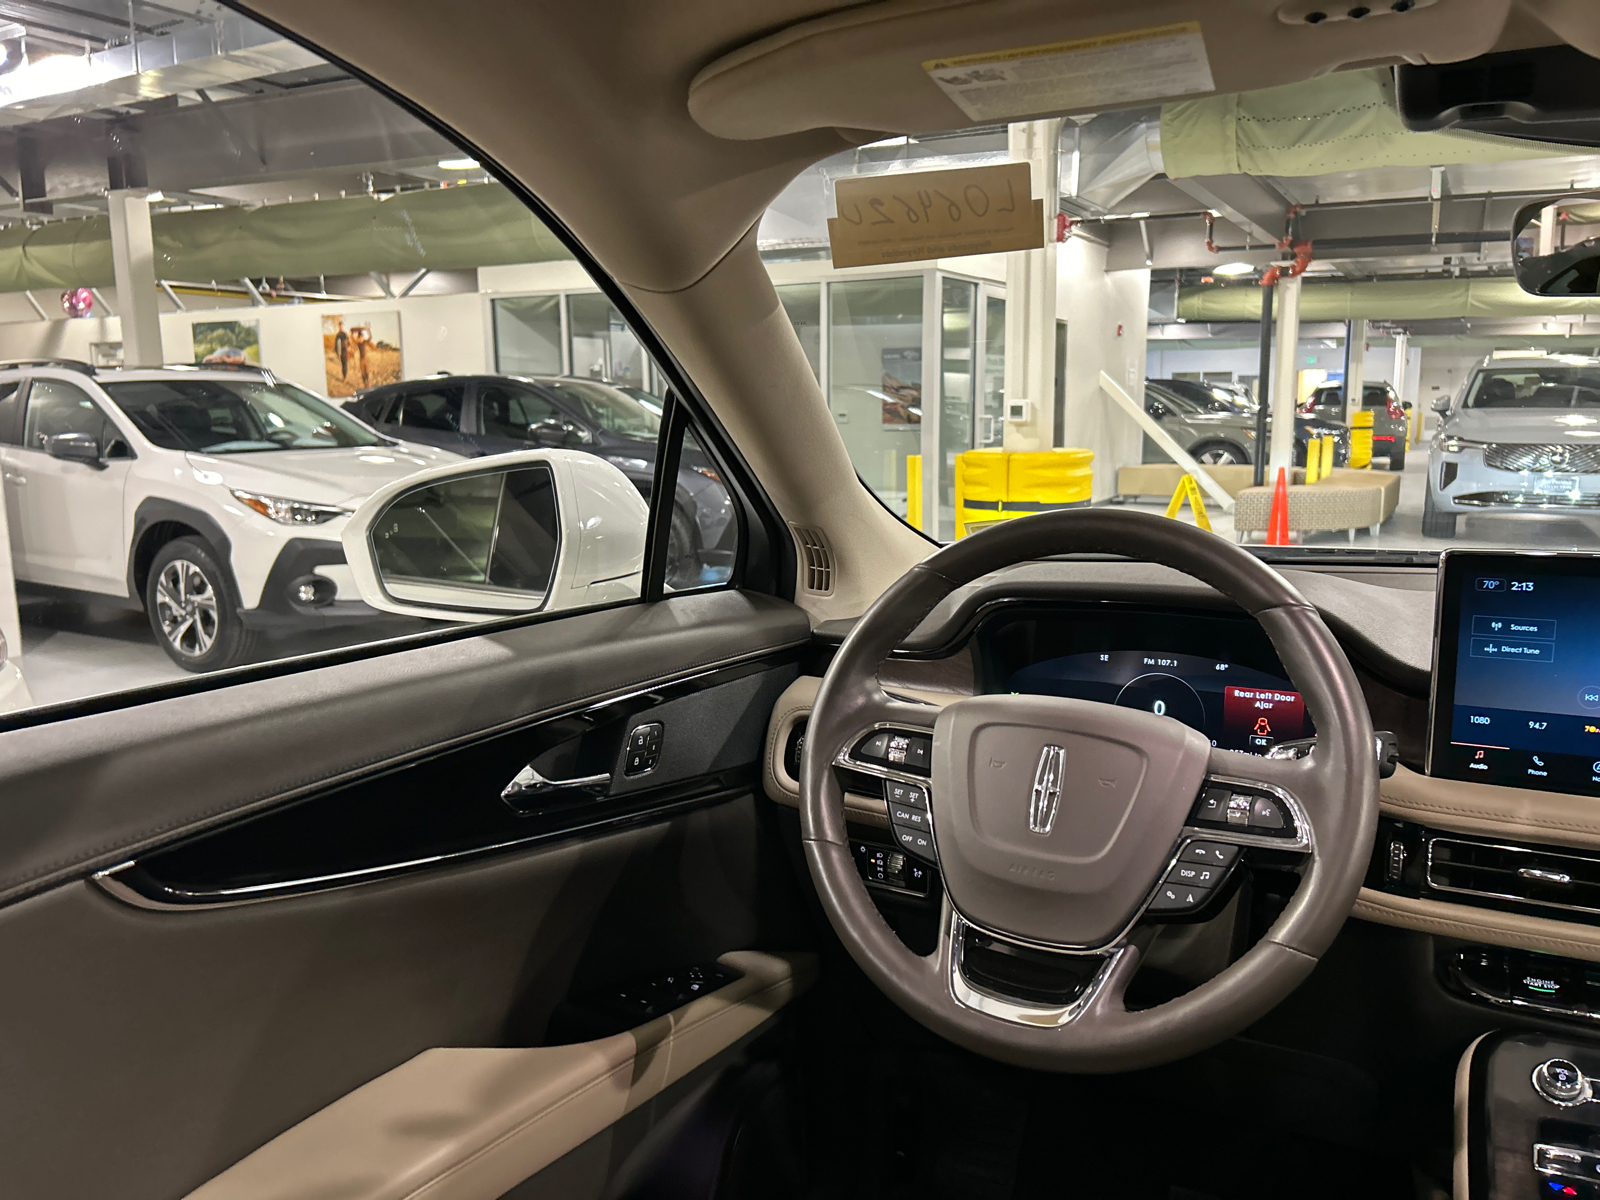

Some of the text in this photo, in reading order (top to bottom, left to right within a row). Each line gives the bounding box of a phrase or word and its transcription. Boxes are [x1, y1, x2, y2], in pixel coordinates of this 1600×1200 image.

[1510, 582, 1534, 591] 2:13
[1510, 624, 1538, 632] Sources
[1523, 647, 1541, 655] Tune
[1143, 657, 1178, 667] FM 107.1
[1234, 690, 1296, 702] Rear Left Door
[1153, 699, 1166, 716] 0
[1254, 701, 1274, 709] Ajar
[1470, 715, 1491, 725] 1080
[1528, 721, 1548, 730] 94.7
[1255, 738, 1267, 746] OK
[1527, 768, 1548, 777] Phone
[894, 788, 919, 799] SET SET
[896, 811, 922, 823] CAN RES
[902, 834, 927, 846] OFF ON
[1180, 869, 1196, 878] DISP
